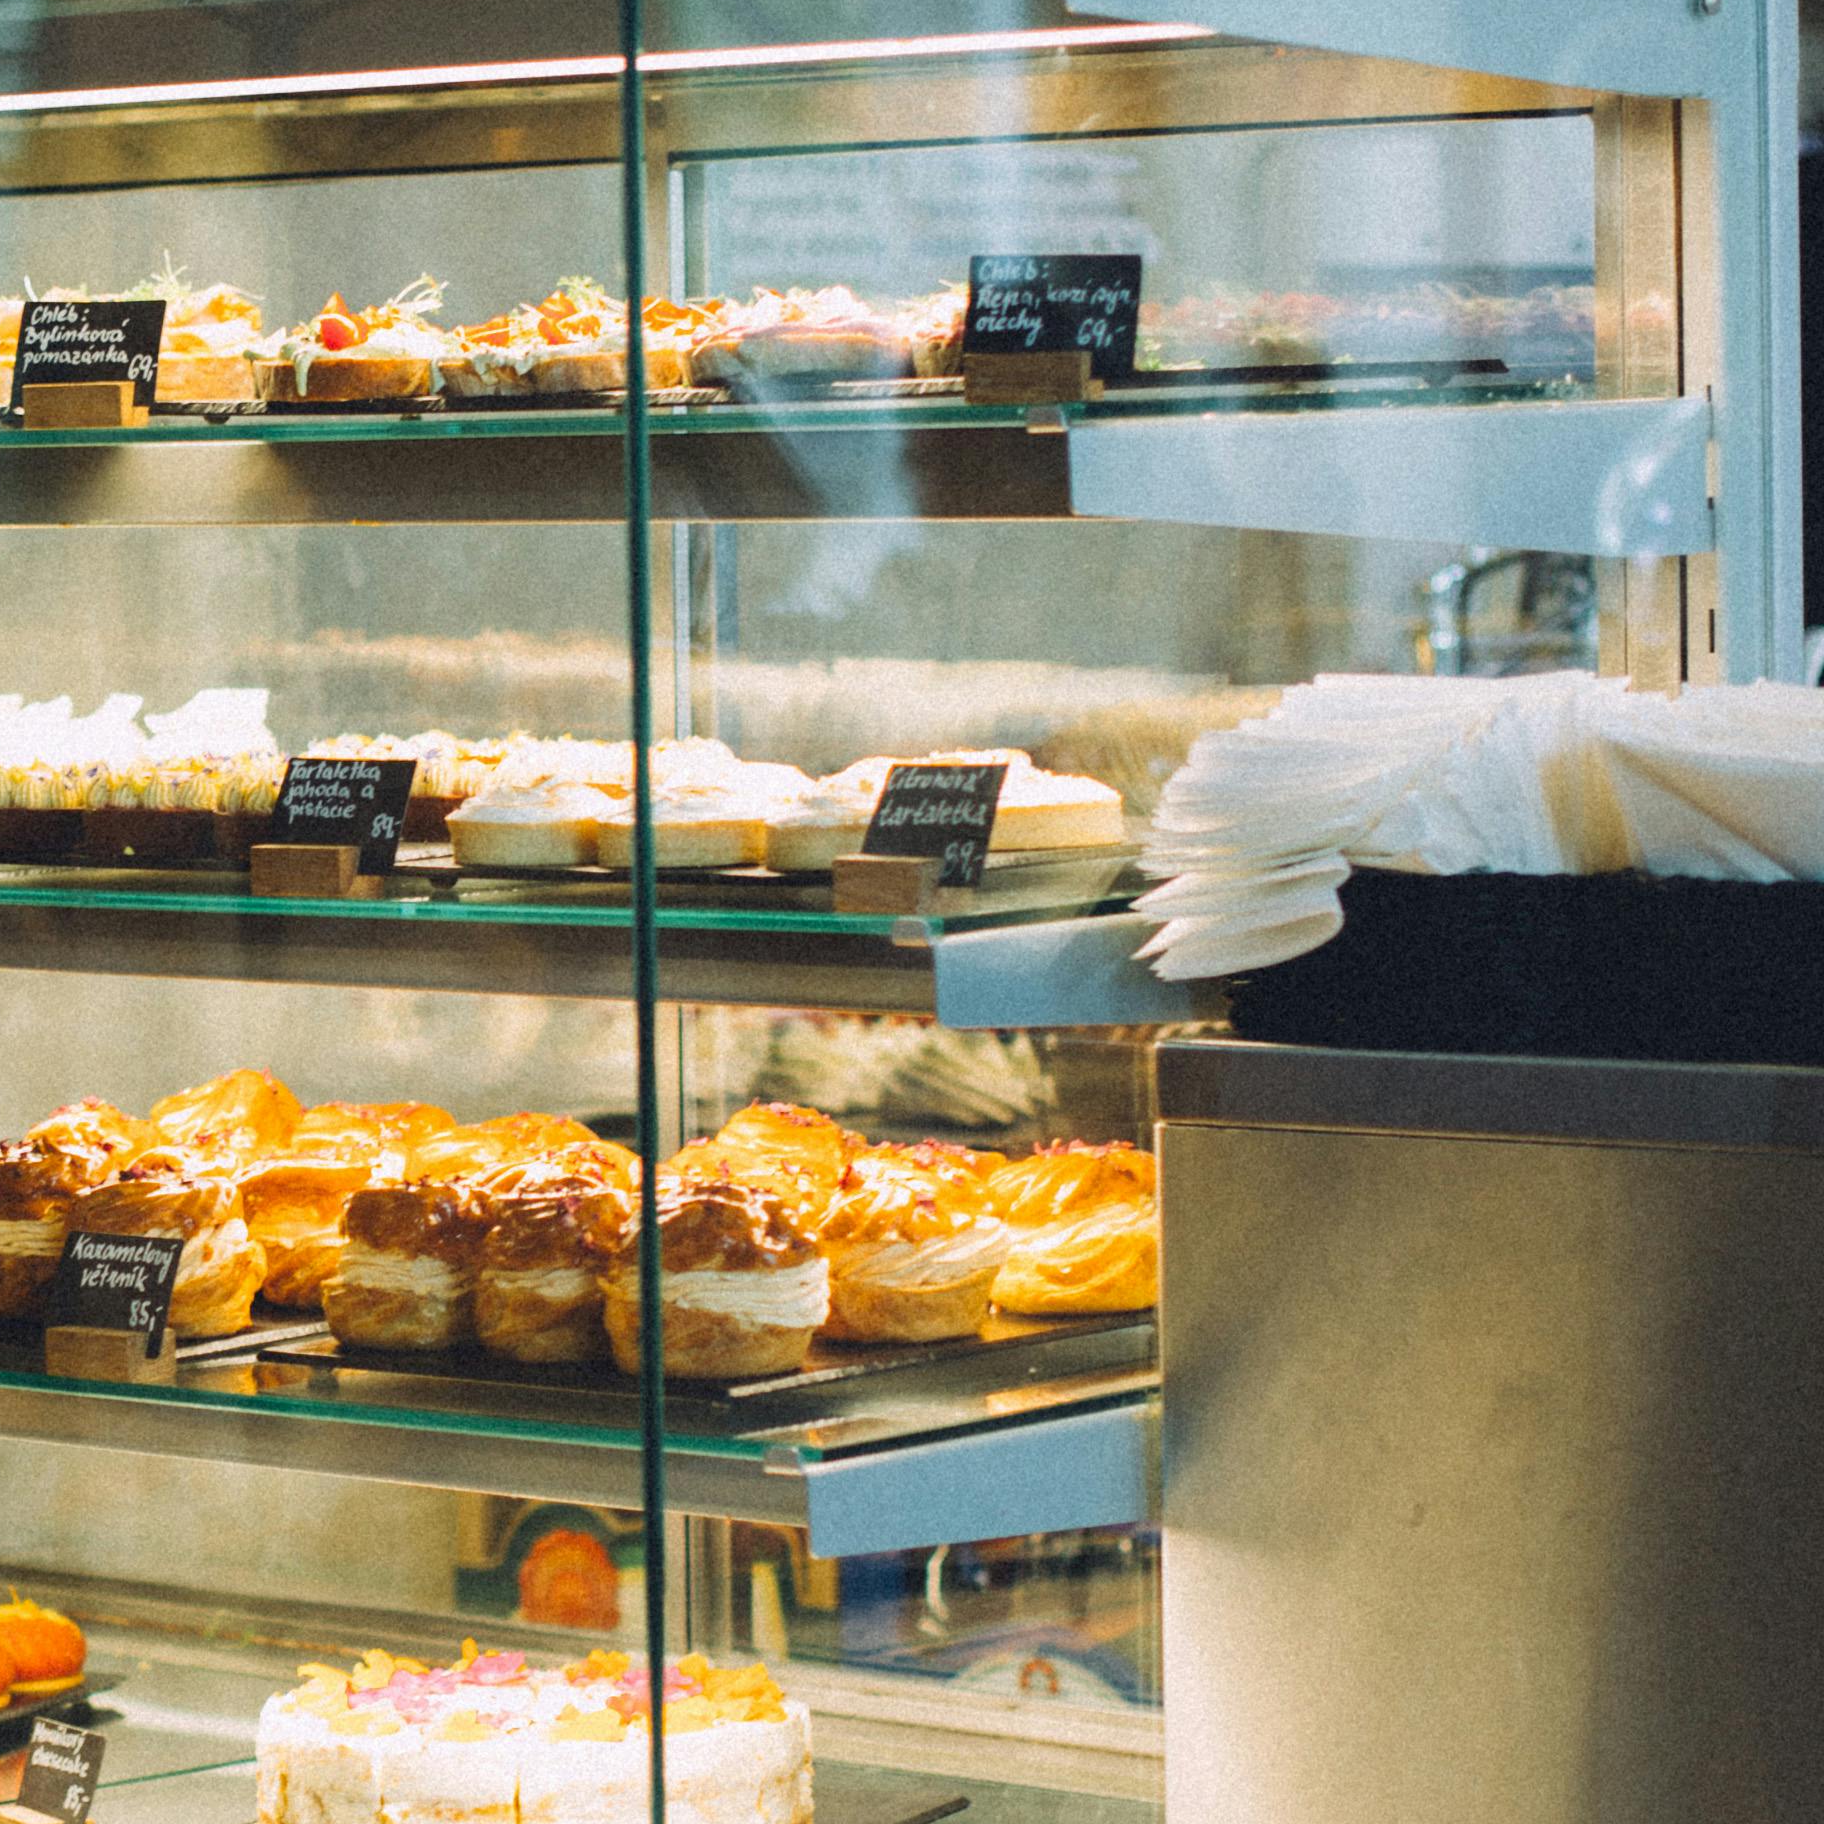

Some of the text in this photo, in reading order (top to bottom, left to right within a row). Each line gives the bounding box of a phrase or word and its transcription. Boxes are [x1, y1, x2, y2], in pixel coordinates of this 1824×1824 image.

[24, 318, 130, 350] Bylinková
[23, 344, 129, 374] pomazánka
[289, 760, 381, 782] Tartaletka
[283, 780, 375, 806] jahoda a
[70, 1232, 178, 1284] Karamelový
[79, 1263, 150, 1292] větrník
